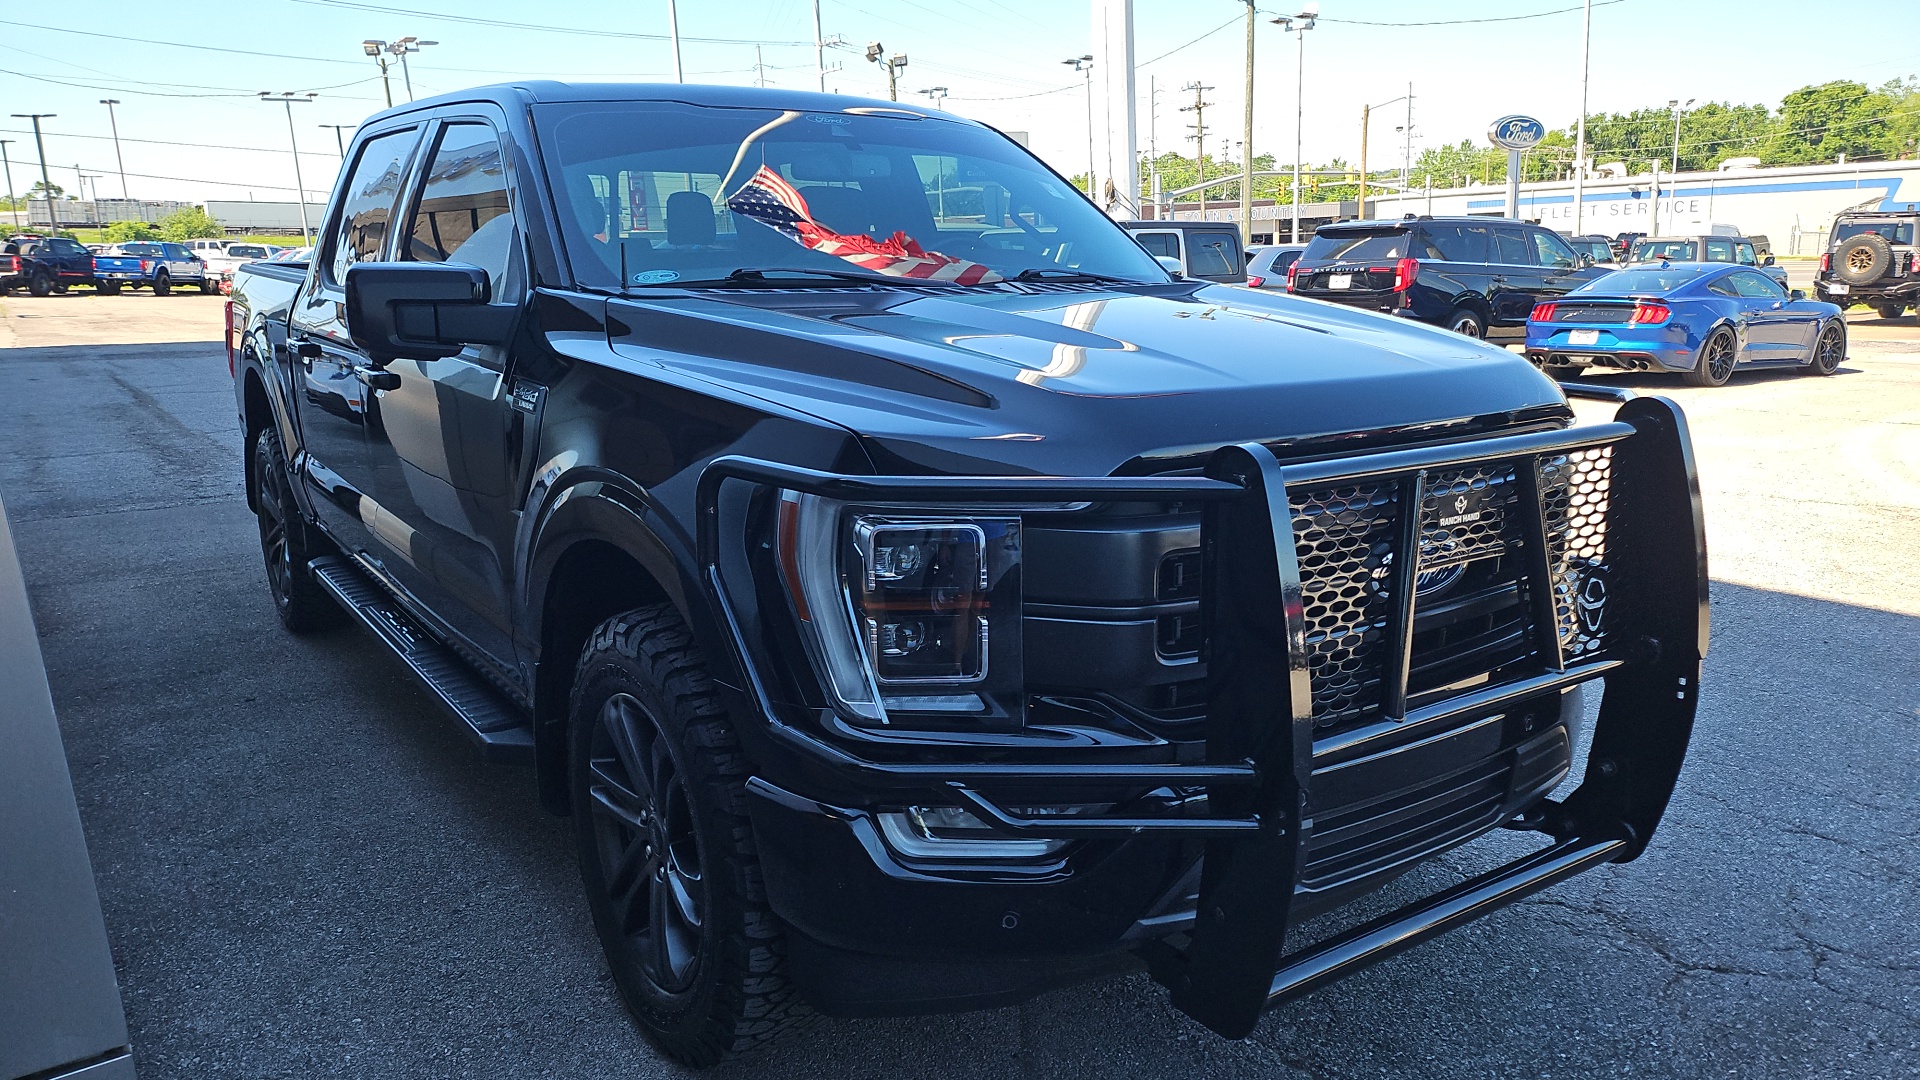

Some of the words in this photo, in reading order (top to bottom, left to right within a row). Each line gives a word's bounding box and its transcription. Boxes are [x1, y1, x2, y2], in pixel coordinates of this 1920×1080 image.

[815, 116, 844, 124] Ford
[1506, 121, 1537, 142] Ford
[1243, 206, 1311, 221] OUNTY
[1440, 515, 1462, 526] RANCH
[1463, 512, 1480, 522] HAND
